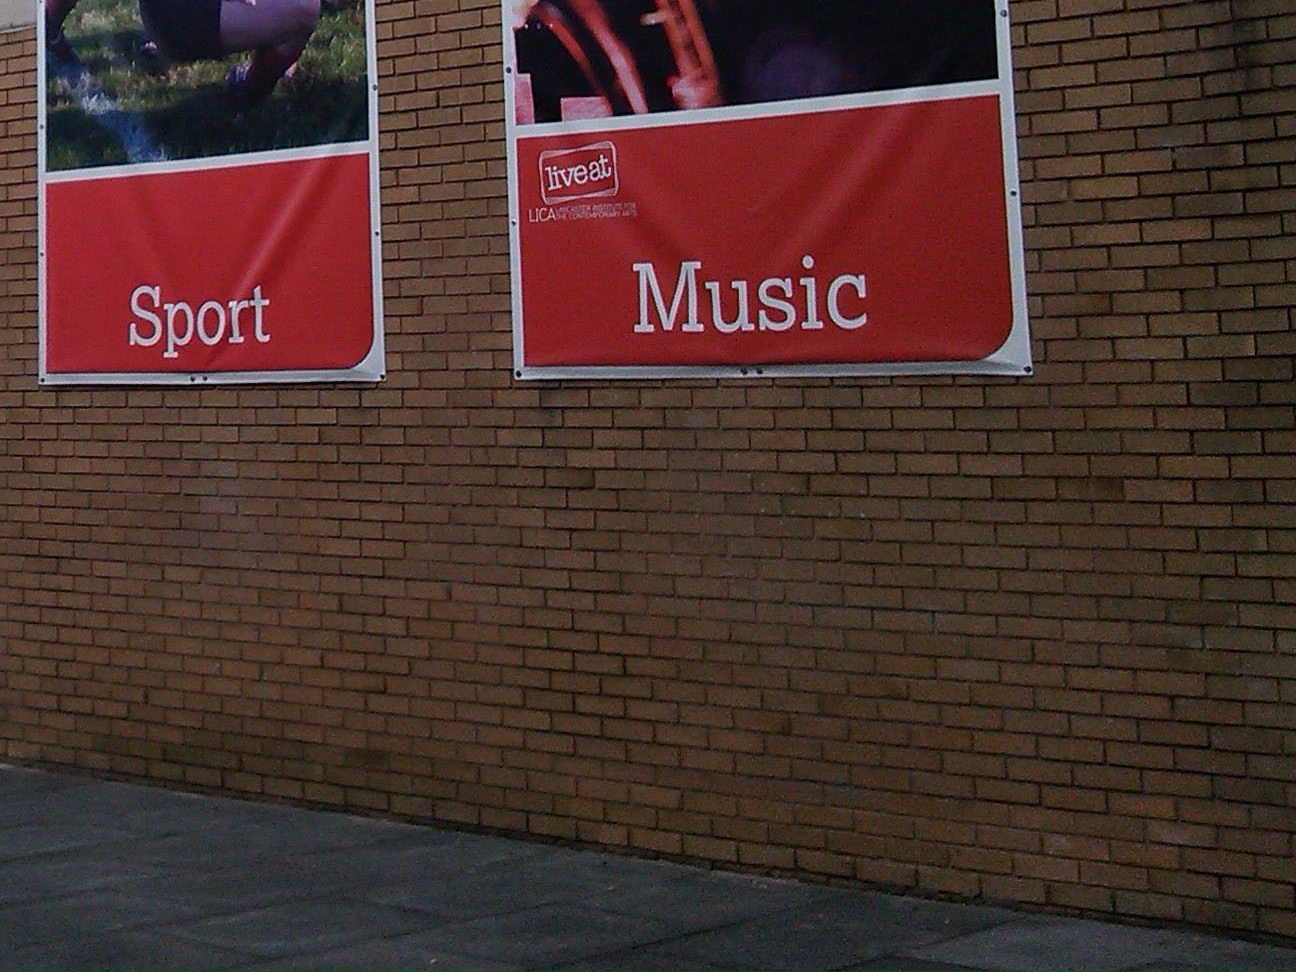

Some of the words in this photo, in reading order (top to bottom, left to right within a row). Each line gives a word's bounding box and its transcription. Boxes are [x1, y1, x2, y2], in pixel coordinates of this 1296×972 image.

[528, 206, 556, 222] LICA
[128, 284, 271, 359] Sport
[632, 255, 868, 334] Music
